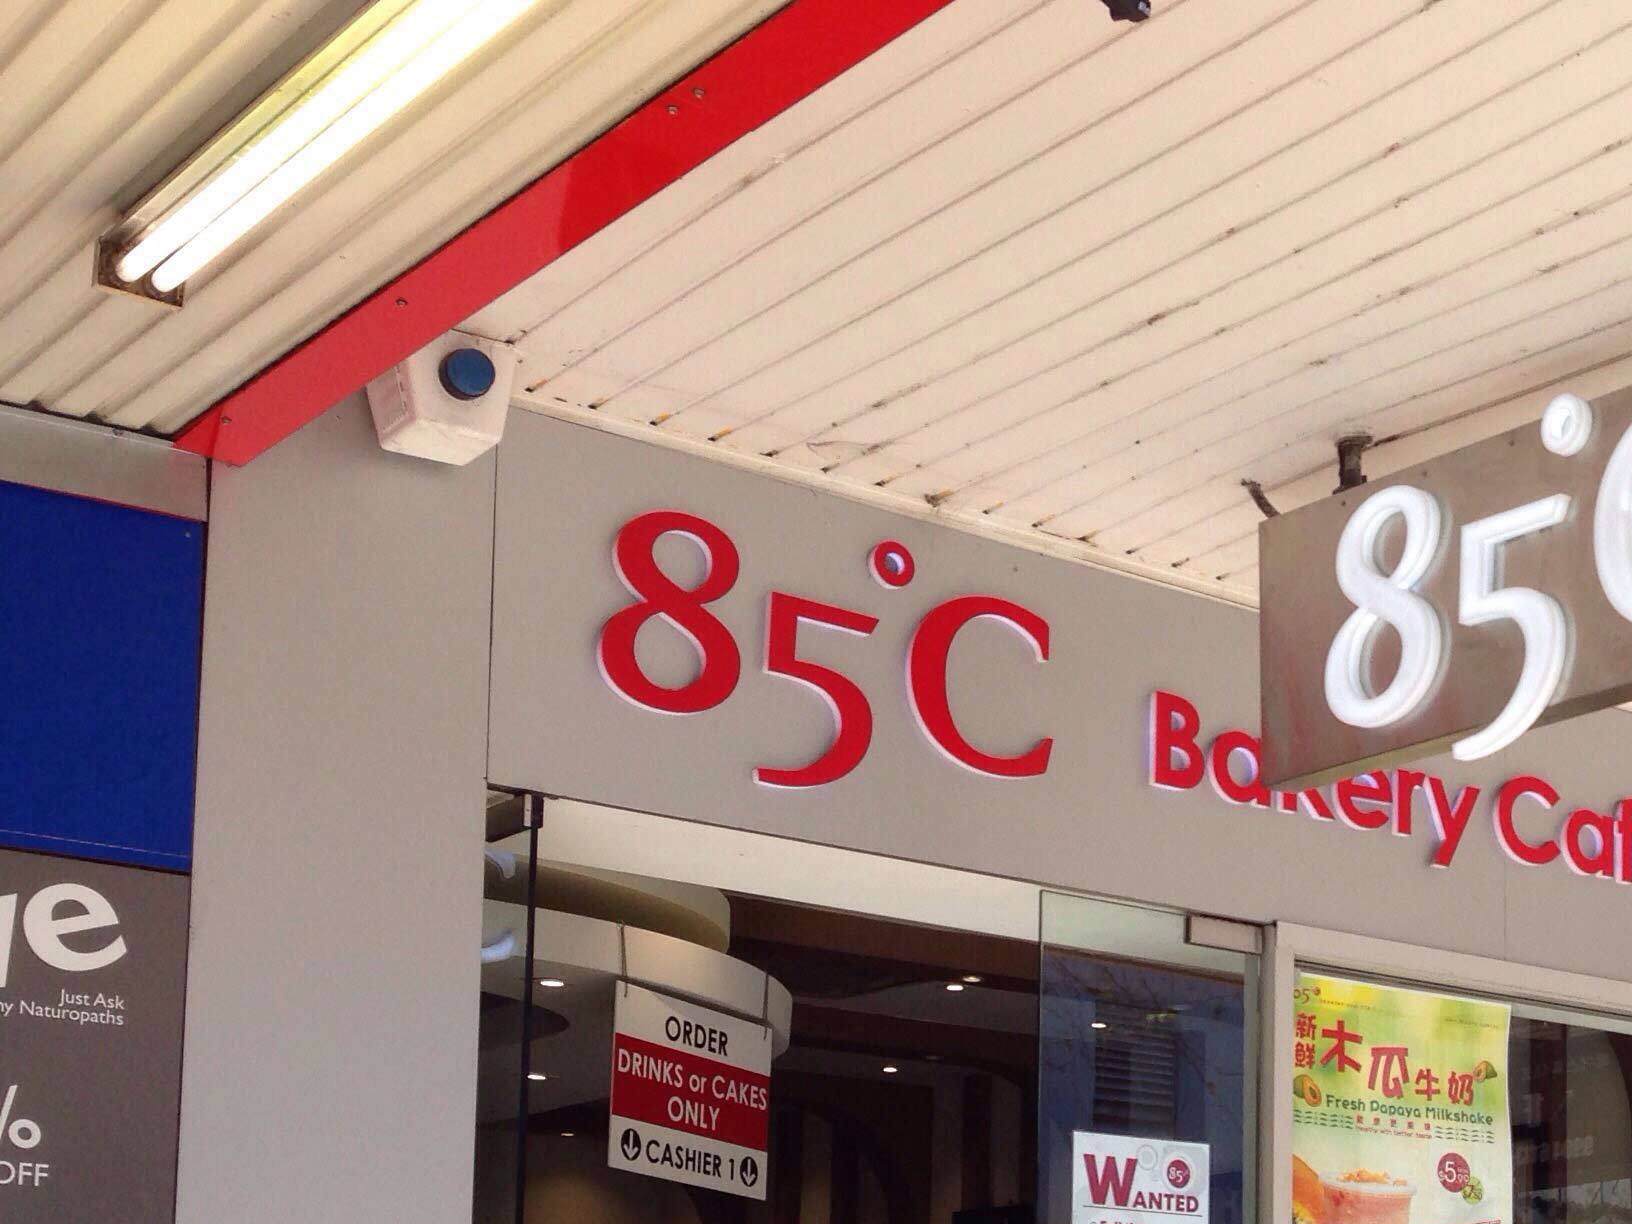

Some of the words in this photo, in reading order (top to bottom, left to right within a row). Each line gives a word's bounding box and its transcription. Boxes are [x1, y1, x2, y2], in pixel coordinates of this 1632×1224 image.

[20, 1000, 124, 1026] Naturopaths
[58, 989, 91, 1008] Just
[94, 993, 125, 1010] Ask
[665, 1016, 728, 1057] ORDER
[617, 1048, 684, 1089] DRINKS
[688, 1073, 708, 1094] or
[711, 1075, 768, 1111] CAKES
[1319, 1019, 1475, 1106] 木瓜牛奶
[667, 1096, 720, 1131] ONLY
[1326, 1094, 1366, 1112] Fresh
[1369, 1100, 1421, 1118] Papaya
[1425, 1107, 1494, 1126] Milkshake
[646, 1139, 722, 1178] CASHIER
[728, 1157, 735, 1181] 1
[1084, 1153, 1199, 1213] WANTED
